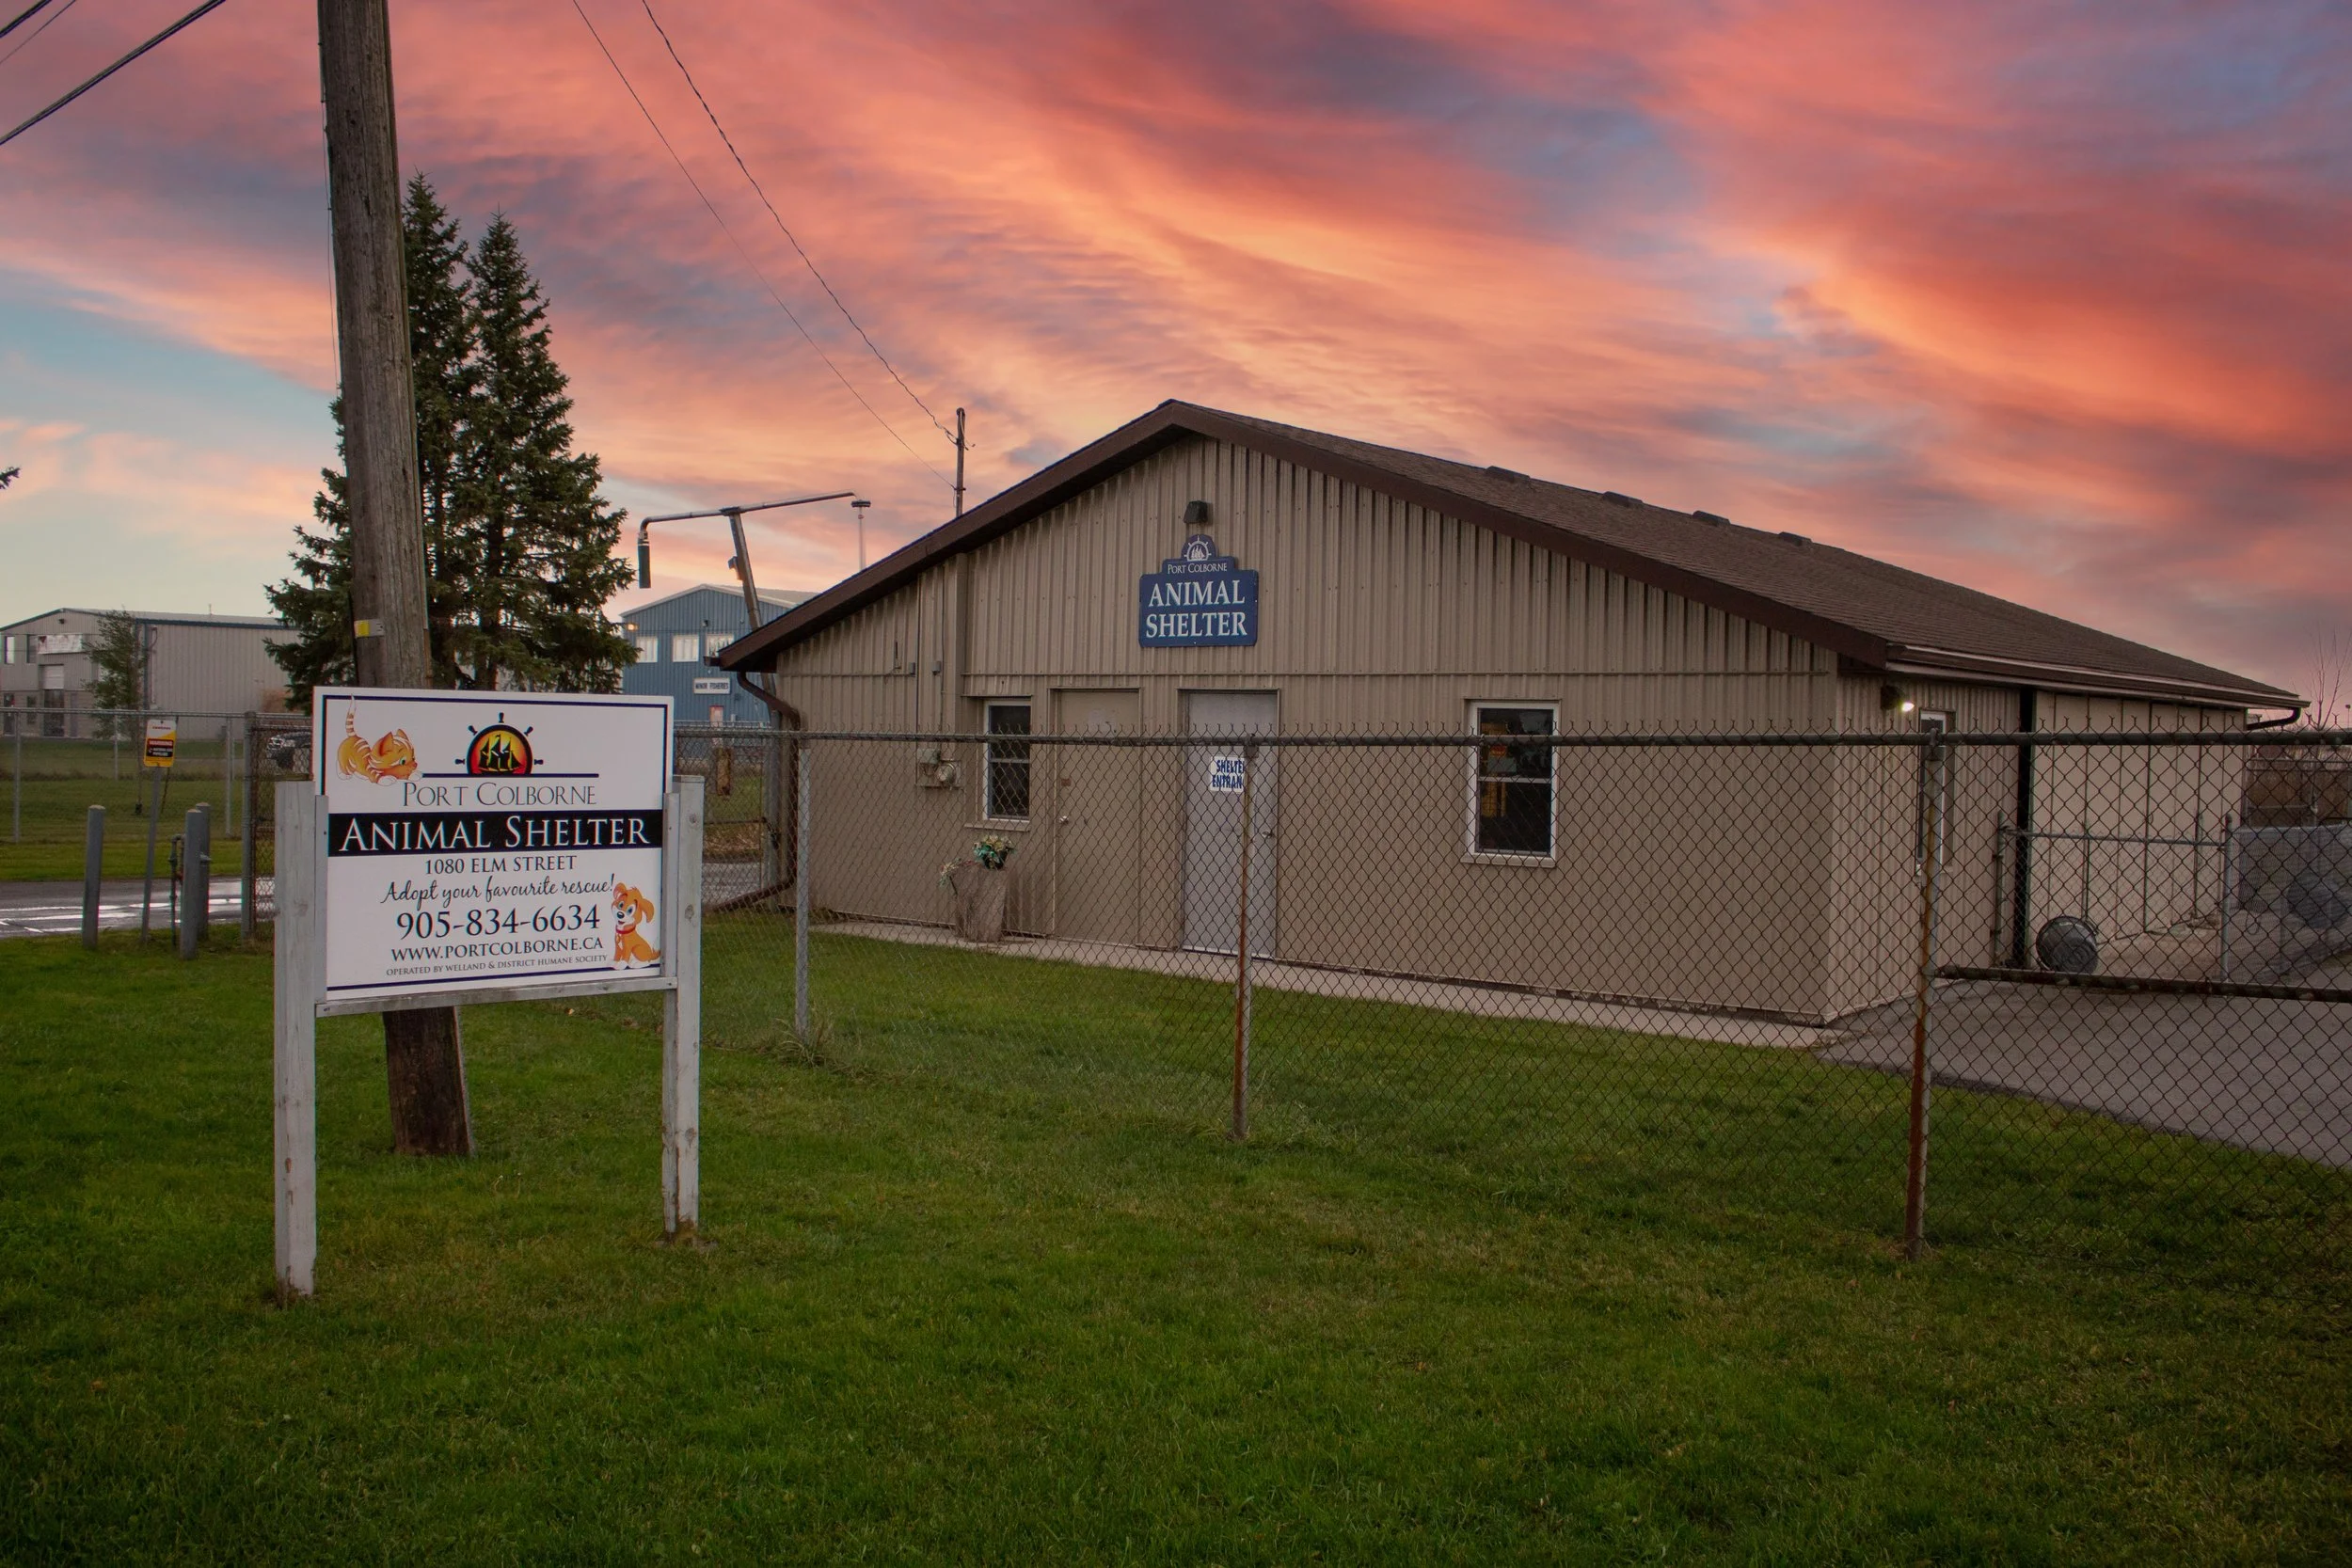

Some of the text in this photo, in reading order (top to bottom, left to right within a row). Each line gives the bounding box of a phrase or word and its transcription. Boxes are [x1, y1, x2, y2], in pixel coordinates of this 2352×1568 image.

[1168, 562, 1228, 575] PORT COLBORNE
[1148, 579, 1246, 608] ANIMAL
[1145, 611, 1248, 639] SHELTER
[1212, 774, 1244, 789] ENTRAN
[403, 782, 597, 807] PORT COLBORNE
[338, 815, 651, 852] ANIMAL SHELTER
[425, 855, 578, 875] 1080 ELM STREET
[380, 872, 615, 911] Adopt your favourite rescue!
[396, 903, 601, 941] 905-834-6634
[391, 937, 604, 962] WWW.PORTCOLBORNE.CA
[386, 954, 609, 976] OPERATED BY WELLAND & DISTRICT HUMANE SOCIETY
